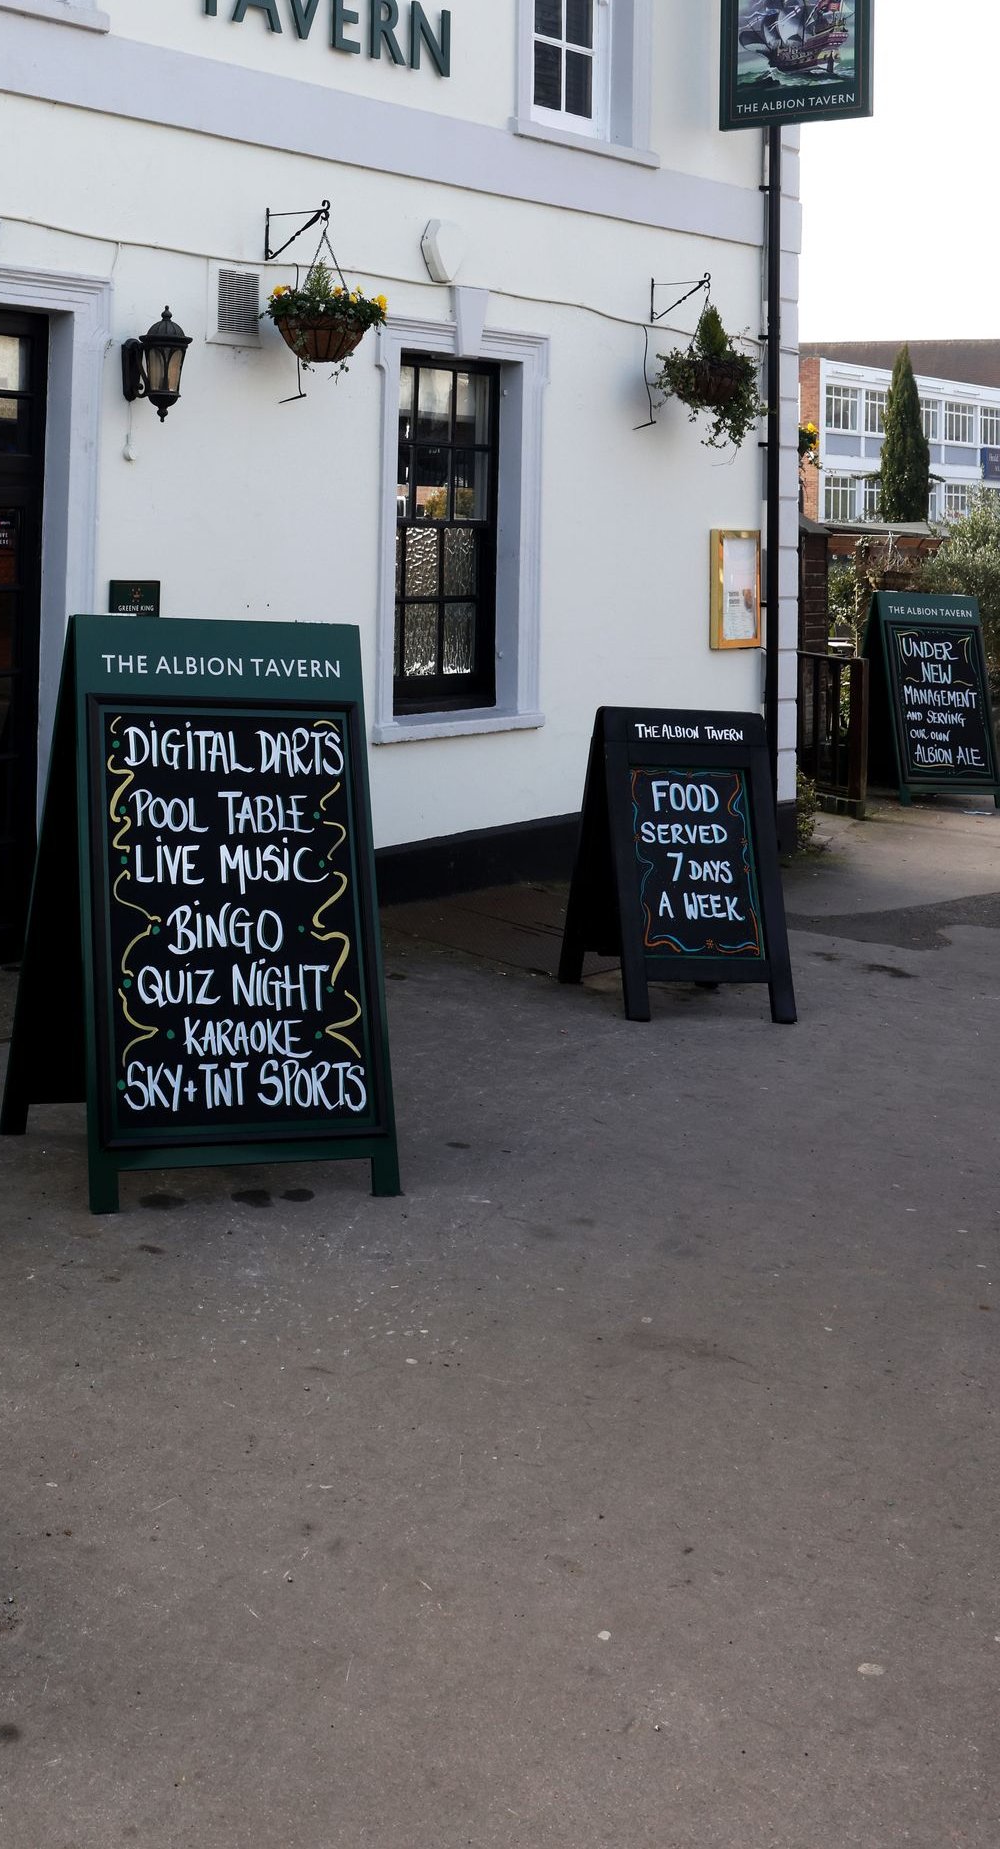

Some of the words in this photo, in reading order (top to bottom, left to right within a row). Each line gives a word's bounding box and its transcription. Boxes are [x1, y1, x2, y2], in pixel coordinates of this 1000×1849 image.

[736, 103, 758, 114] THE
[761, 98, 805, 112] ALBION
[808, 93, 855, 107] TAVERN
[117, 604, 139, 612] GREENE
[140, 604, 154, 612] KING
[888, 605, 905, 615] THE
[907, 607, 938, 617] ALBION
[940, 608, 973, 618] TAVERN
[902, 637, 959, 661] UNDER
[101, 654, 148, 674] THE
[155, 656, 243, 676] ALBION
[250, 658, 341, 678] TAVERN
[921, 661, 952, 685] NEW
[903, 684, 977, 709] MANAGEMENT
[906, 711, 923, 721] AND
[926, 710, 967, 728] SERVING
[635, 723, 660, 739] THE
[662, 723, 699, 740] ALBION
[704, 726, 743, 741] TAVERN
[909, 729, 929, 740] OUR
[930, 729, 950, 742] OWN
[123, 720, 255, 775] DIGITAL
[254, 727, 344, 778] DARTS
[914, 743, 953, 764] ALBION
[956, 745, 985, 767] ALE
[651, 780, 719, 813] FOOD
[128, 789, 209, 833] POOL
[217, 791, 315, 835] TABLE
[640, 821, 728, 845] SERVED
[135, 835, 205, 885] LIVE
[219, 836, 330, 895] MUSIC
[667, 852, 683, 882] 7
[688, 860, 733, 884] DAYS
[658, 891, 674, 919] A
[684, 892, 745, 921] WEEK
[166, 900, 283, 955] BINGO
[137, 962, 222, 1008] QUIZ
[232, 958, 330, 1012] NIGHT
[183, 1016, 313, 1058] KARAOKE
[257, 1059, 367, 1112] SPORTS
